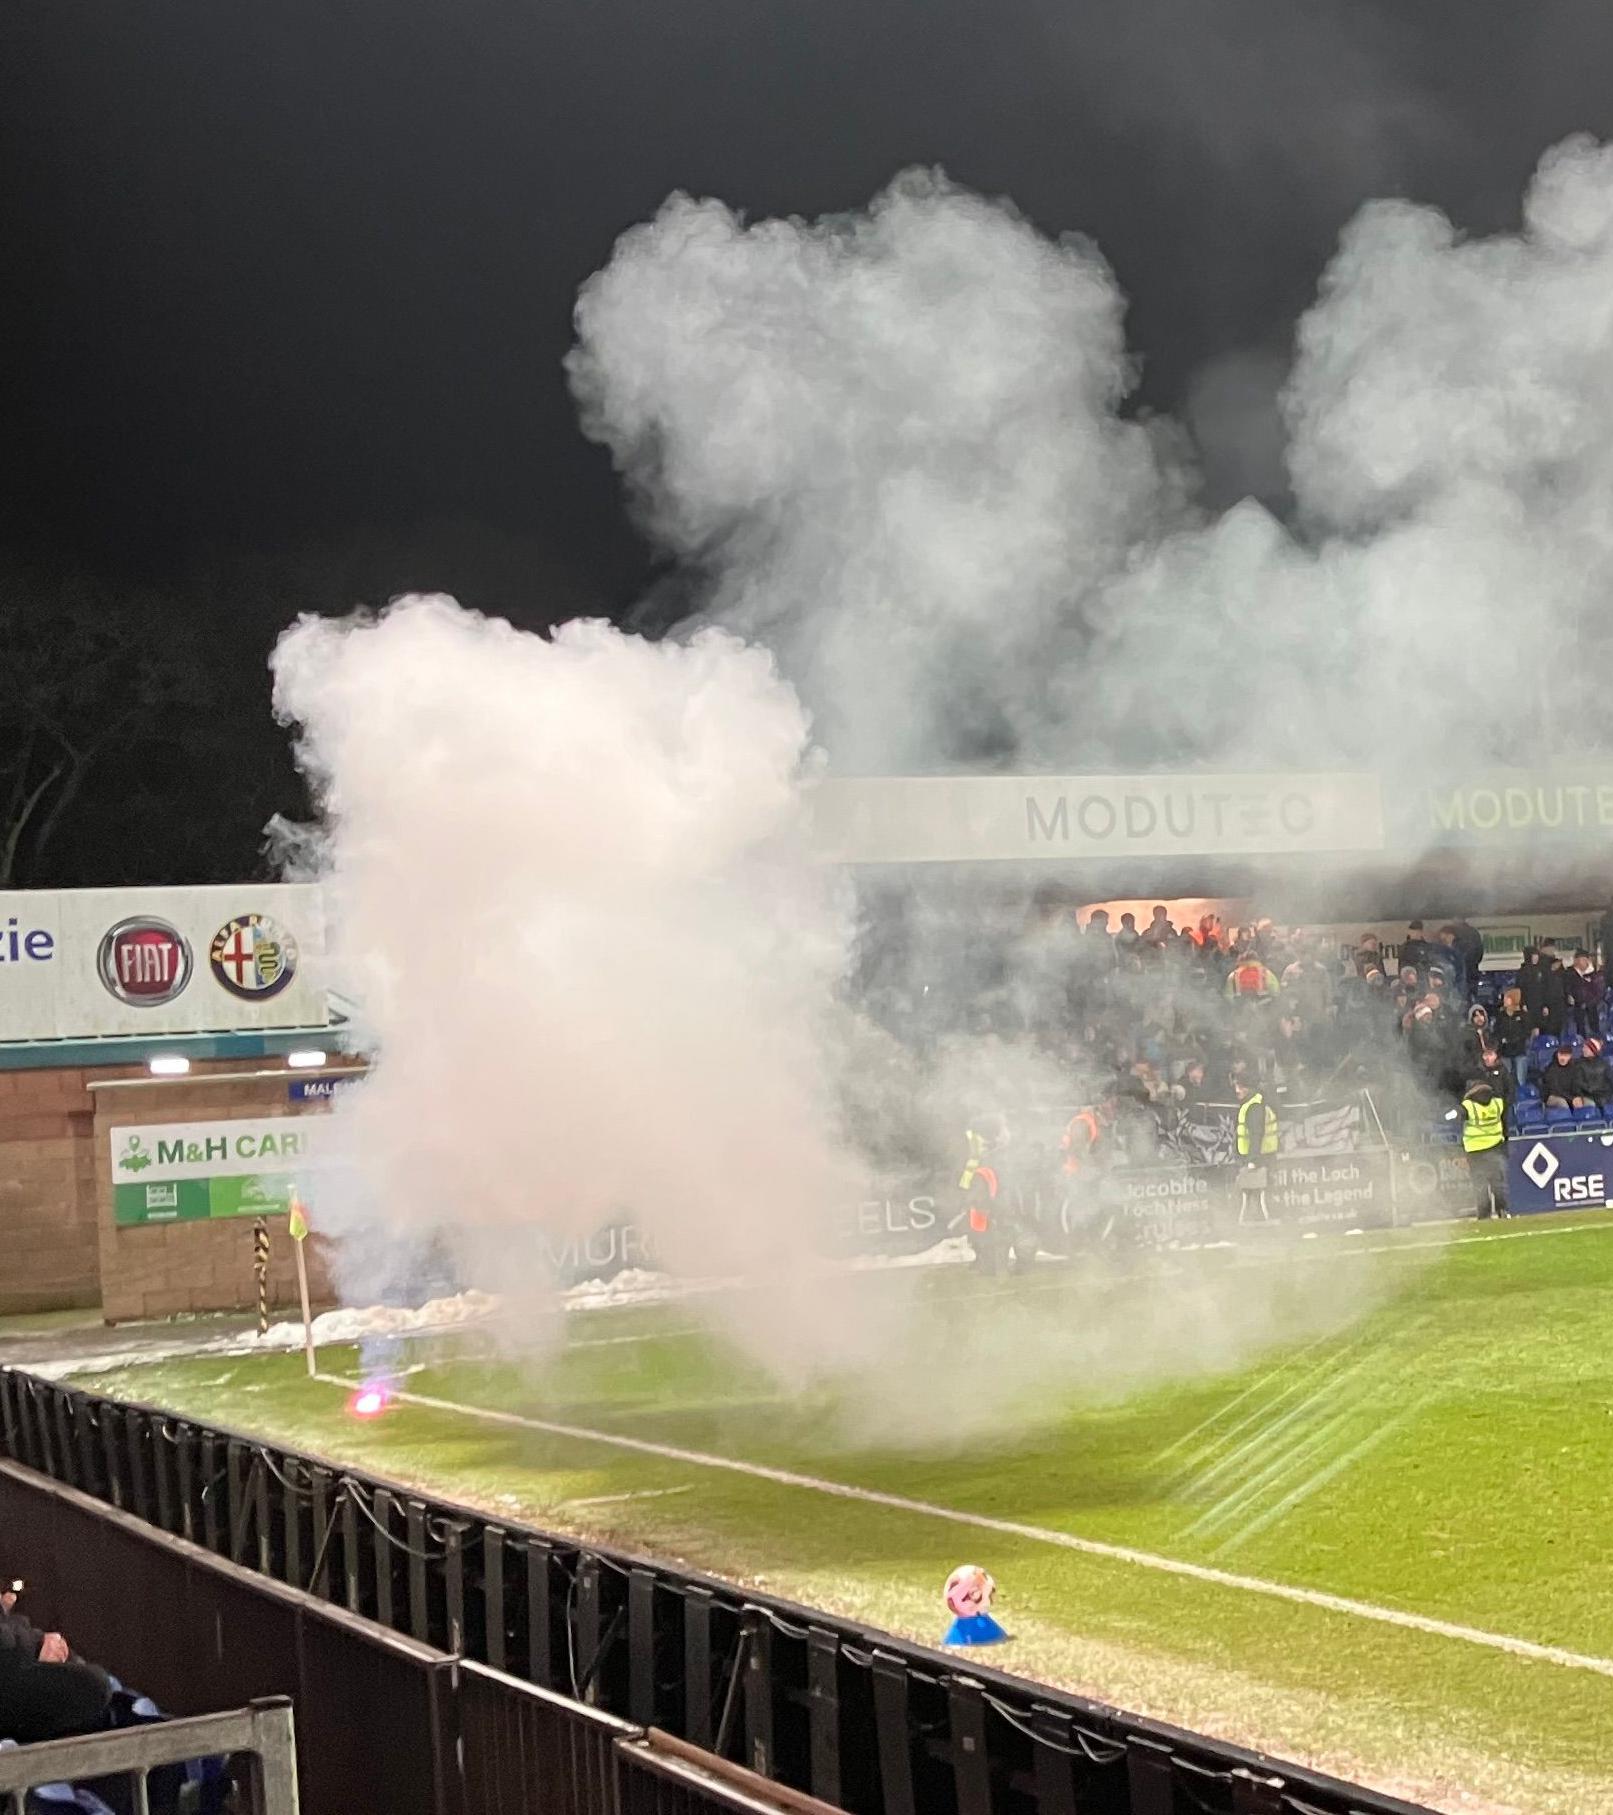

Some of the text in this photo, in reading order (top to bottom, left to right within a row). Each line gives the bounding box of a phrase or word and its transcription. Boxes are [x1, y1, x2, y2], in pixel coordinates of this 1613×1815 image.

[0, 917, 54, 962] ie
[120, 942, 173, 984] FIAT
[157, 1136, 227, 1165] M&H
[1553, 1174, 1605, 1201] RSE
